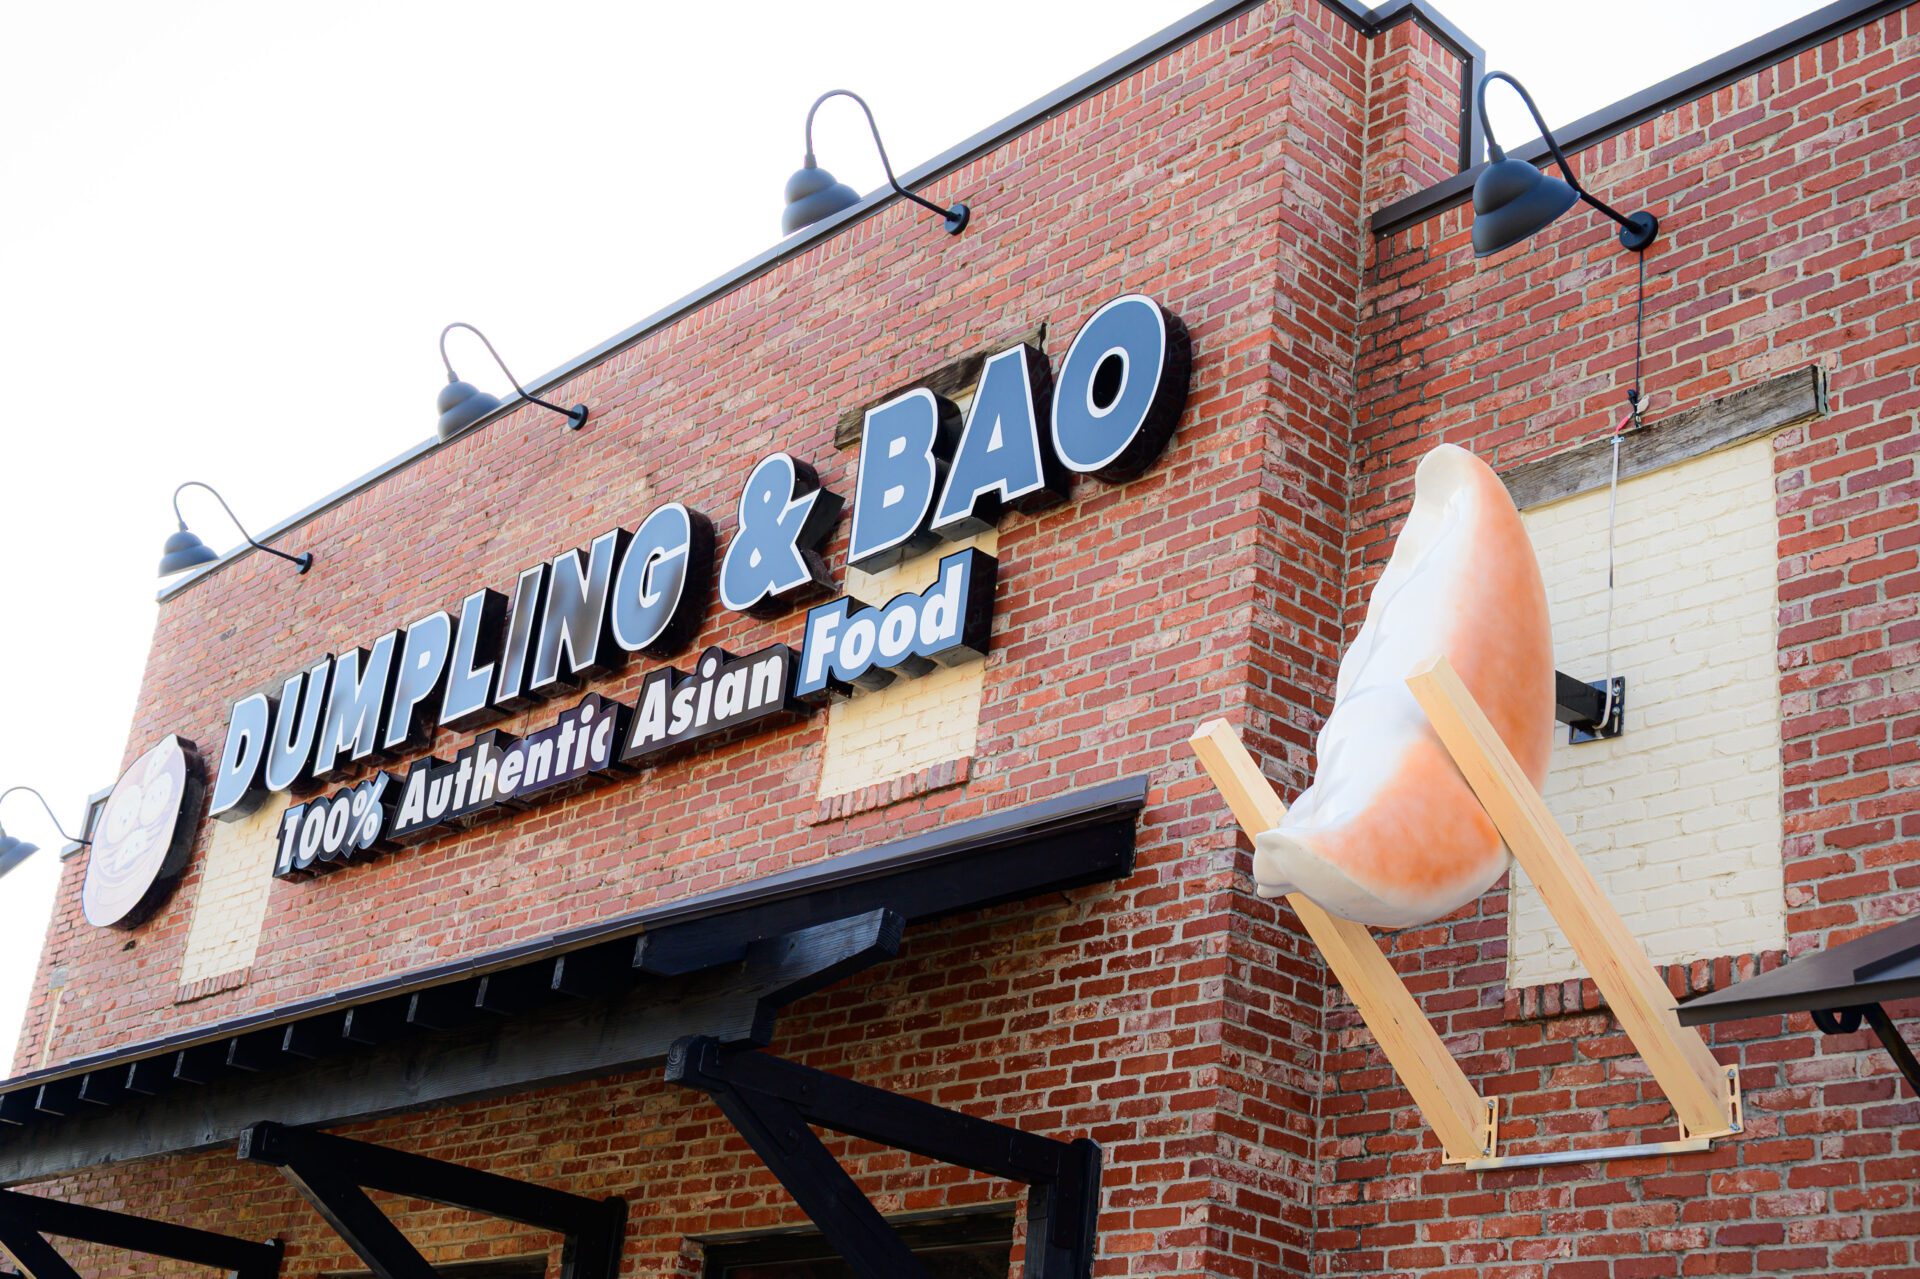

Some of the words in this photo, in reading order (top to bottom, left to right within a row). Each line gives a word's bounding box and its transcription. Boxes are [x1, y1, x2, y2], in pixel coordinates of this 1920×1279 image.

[208, 502, 692, 818] DUMPLING
[719, 452, 821, 612] &
[847, 293, 1167, 565] BAO
[278, 772, 389, 869] 100%
[395, 704, 610, 830] Authentic
[630, 650, 784, 749] Asian
[804, 561, 964, 686] Food
